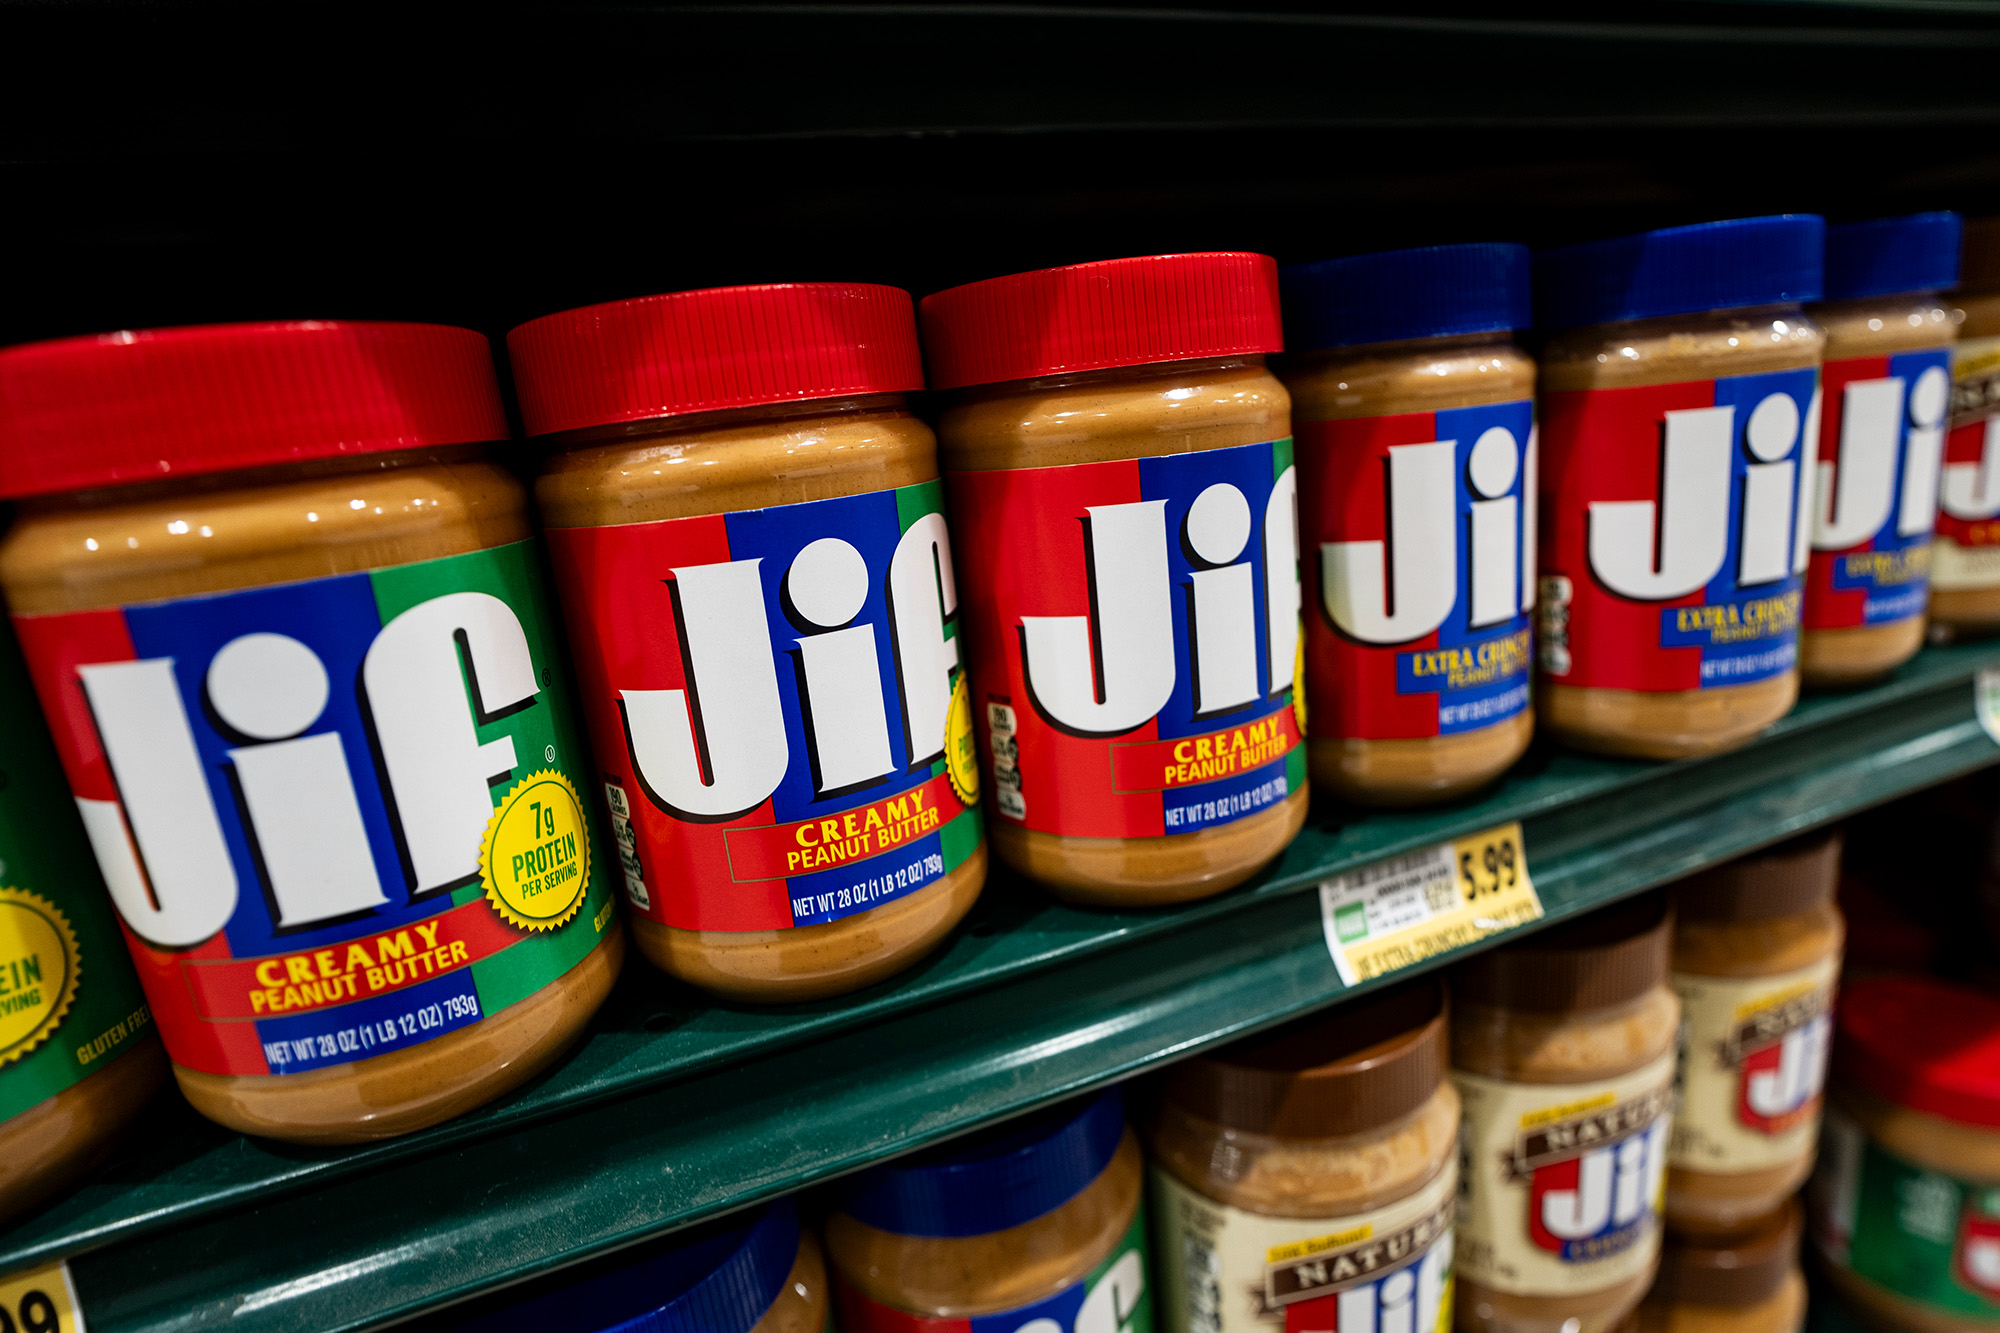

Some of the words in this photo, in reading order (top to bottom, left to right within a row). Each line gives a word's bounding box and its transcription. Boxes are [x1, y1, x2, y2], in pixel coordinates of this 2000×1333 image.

[617, 511, 958, 820] Jif
[1164, 753, 1237, 785] PEANUT
[1240, 733, 1288, 769] BUTTER
[1173, 716, 1279, 764] CREAMY
[75, 591, 541, 950] Jif
[529, 801, 555, 840] 7g
[786, 833, 871, 871] PEANUT
[877, 806, 940, 849] BUTTER
[795, 788, 924, 848] CREAMY
[1165, 807, 1185, 826] NET
[1186, 804, 1202, 823] WT
[1217, 798, 1230, 817] OZ
[511, 831, 578, 883] PROTEIN
[521, 878, 543, 900] PER
[544, 861, 578, 891] SERVING
[1459, 838, 1516, 902] 5.99
[792, 897, 815, 918] NET
[816, 892, 836, 913] WT
[837, 888, 852, 909] 28
[852, 883, 868, 904] OZ
[869, 878, 879, 901] (1
[880, 878, 895, 895] LB
[894, 868, 907, 889] 12
[907, 860, 924, 882] OZ)
[249, 973, 357, 1013] PEANUT
[365, 939, 470, 991] BUTTER
[254, 919, 439, 988] CREAMY
[76, 1021, 128, 1066] GLUTEN
[263, 1040, 292, 1065] NET
[290, 1036, 317, 1062] WT
[316, 1033, 339, 1058] 28
[337, 1028, 360, 1053] OZ
[359, 1024, 376, 1050] (1
[376, 1018, 398, 1044] LB
[397, 1012, 418, 1036] 12
[417, 1002, 445, 1031] OZ)
[442, 994, 479, 1021] 793g
